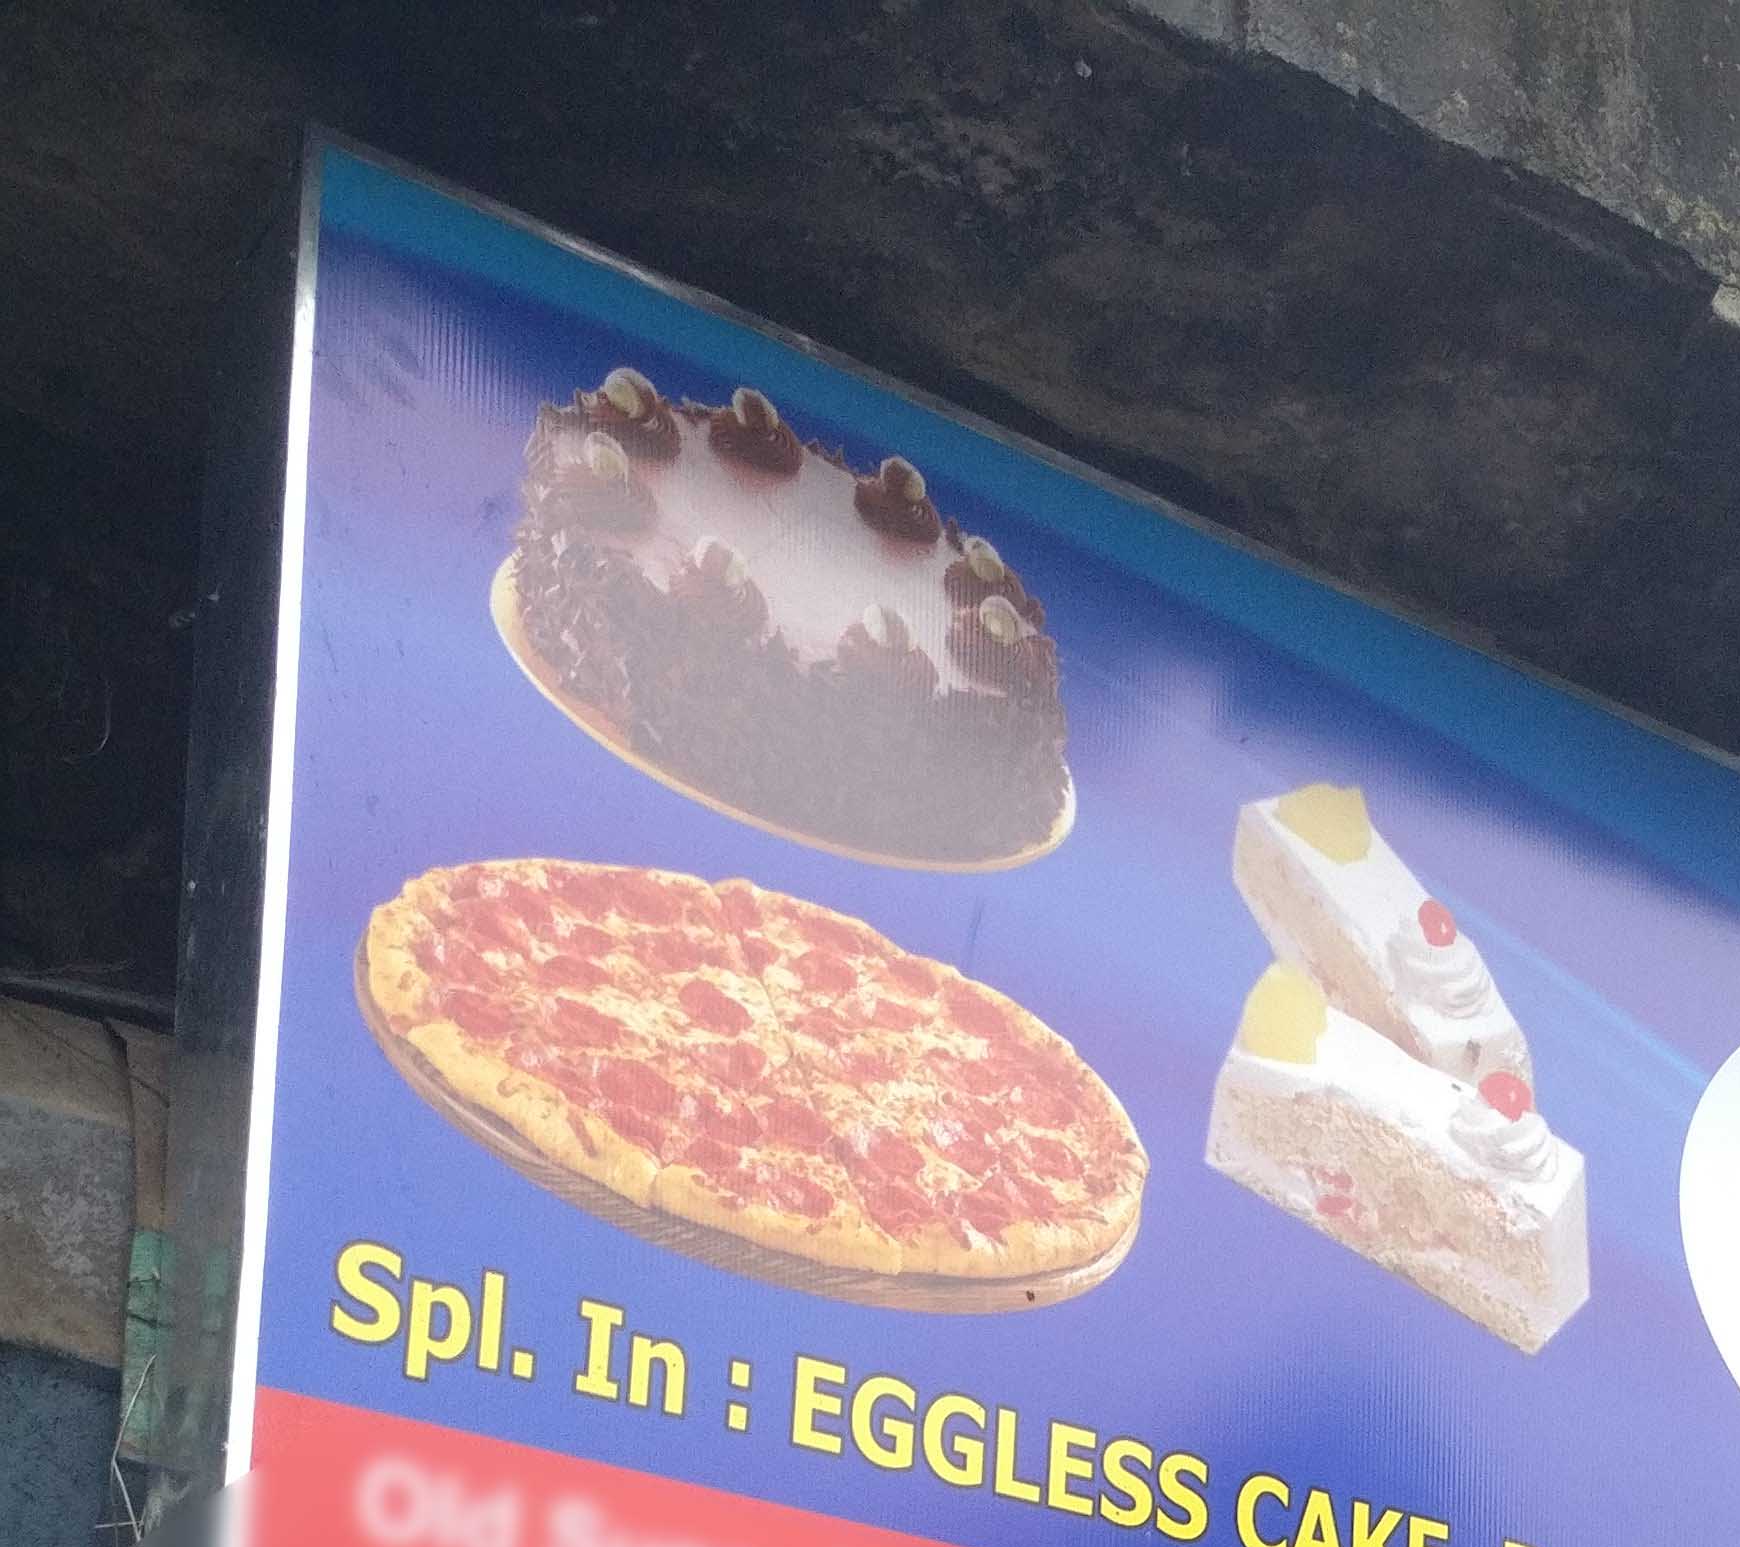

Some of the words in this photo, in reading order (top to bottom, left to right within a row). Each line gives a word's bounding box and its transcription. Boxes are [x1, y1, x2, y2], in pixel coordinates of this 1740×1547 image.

[330, 1240, 534, 1383] Spl.
[575, 1300, 687, 1415] In
[791, 1354, 1209, 1541] EGGLESS
